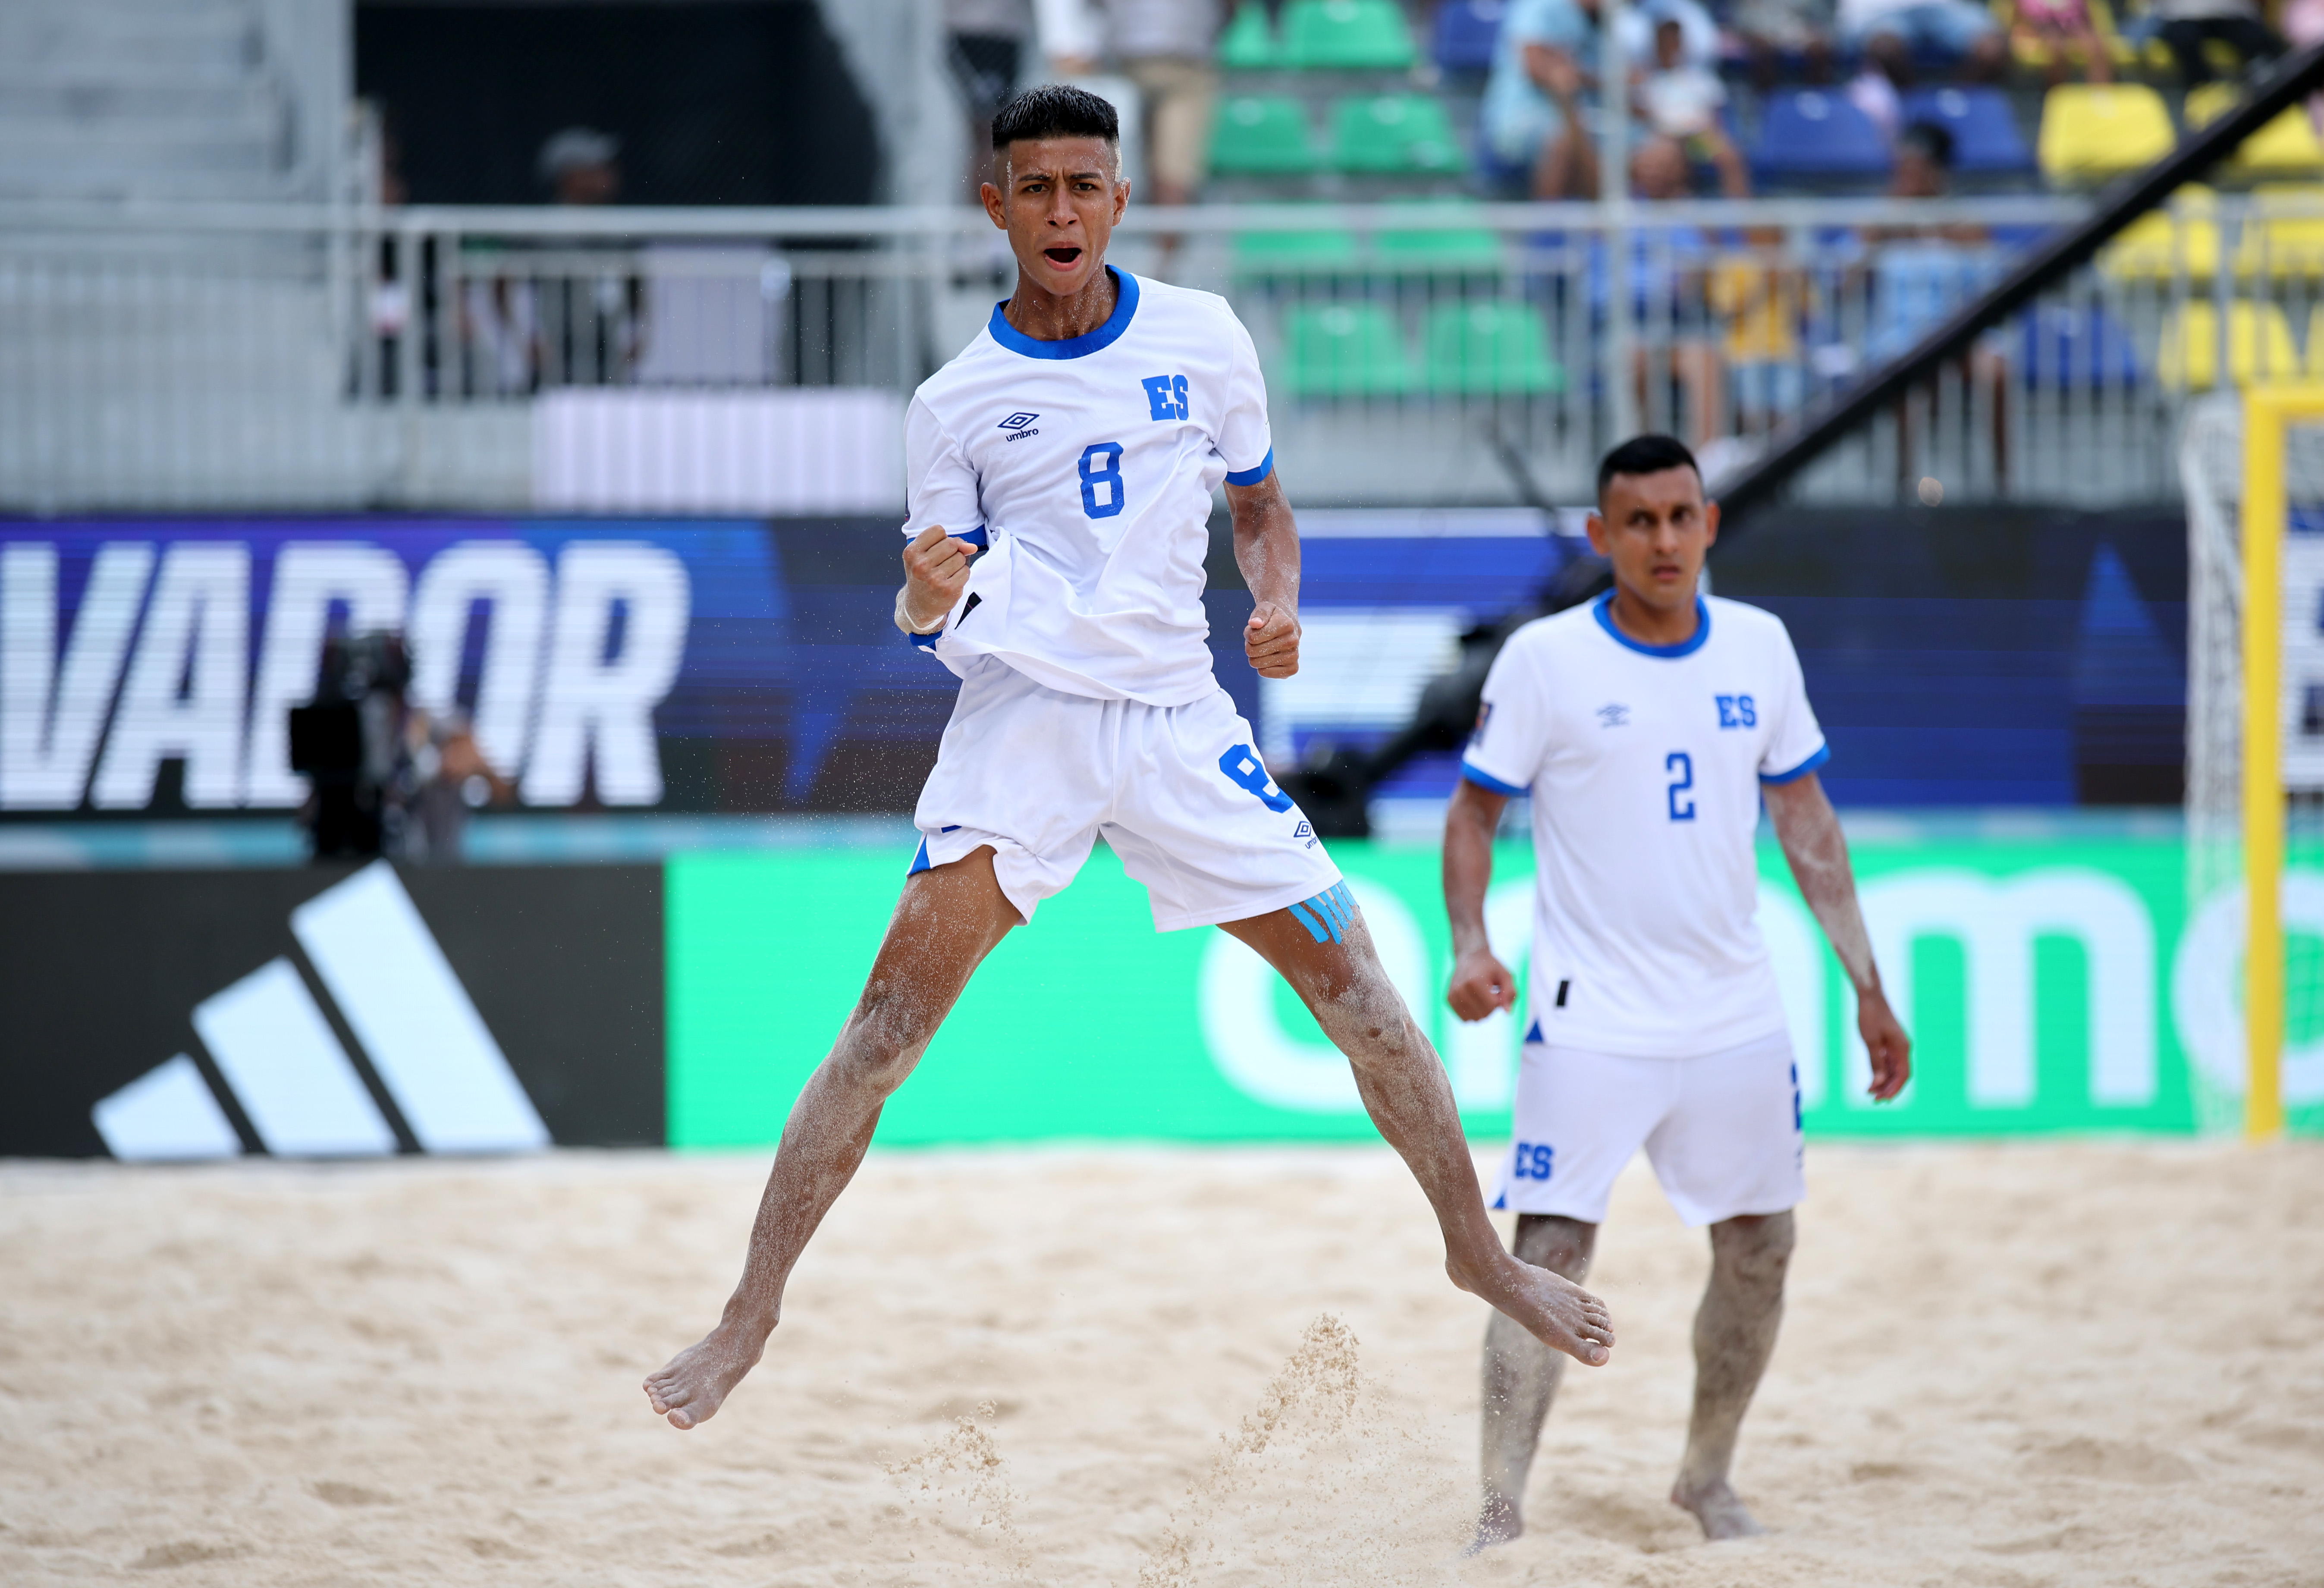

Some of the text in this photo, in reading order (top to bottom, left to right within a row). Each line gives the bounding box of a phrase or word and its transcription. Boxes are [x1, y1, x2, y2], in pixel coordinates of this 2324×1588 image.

[1141, 374, 1189, 421] ES
[1005, 428, 1039, 442] umbro
[1078, 441, 1125, 520] 8
[1714, 694, 1758, 730] ES
[1219, 743, 1294, 814] 8
[1665, 751, 1697, 823] 2
[1515, 1141, 1554, 1181] ES
